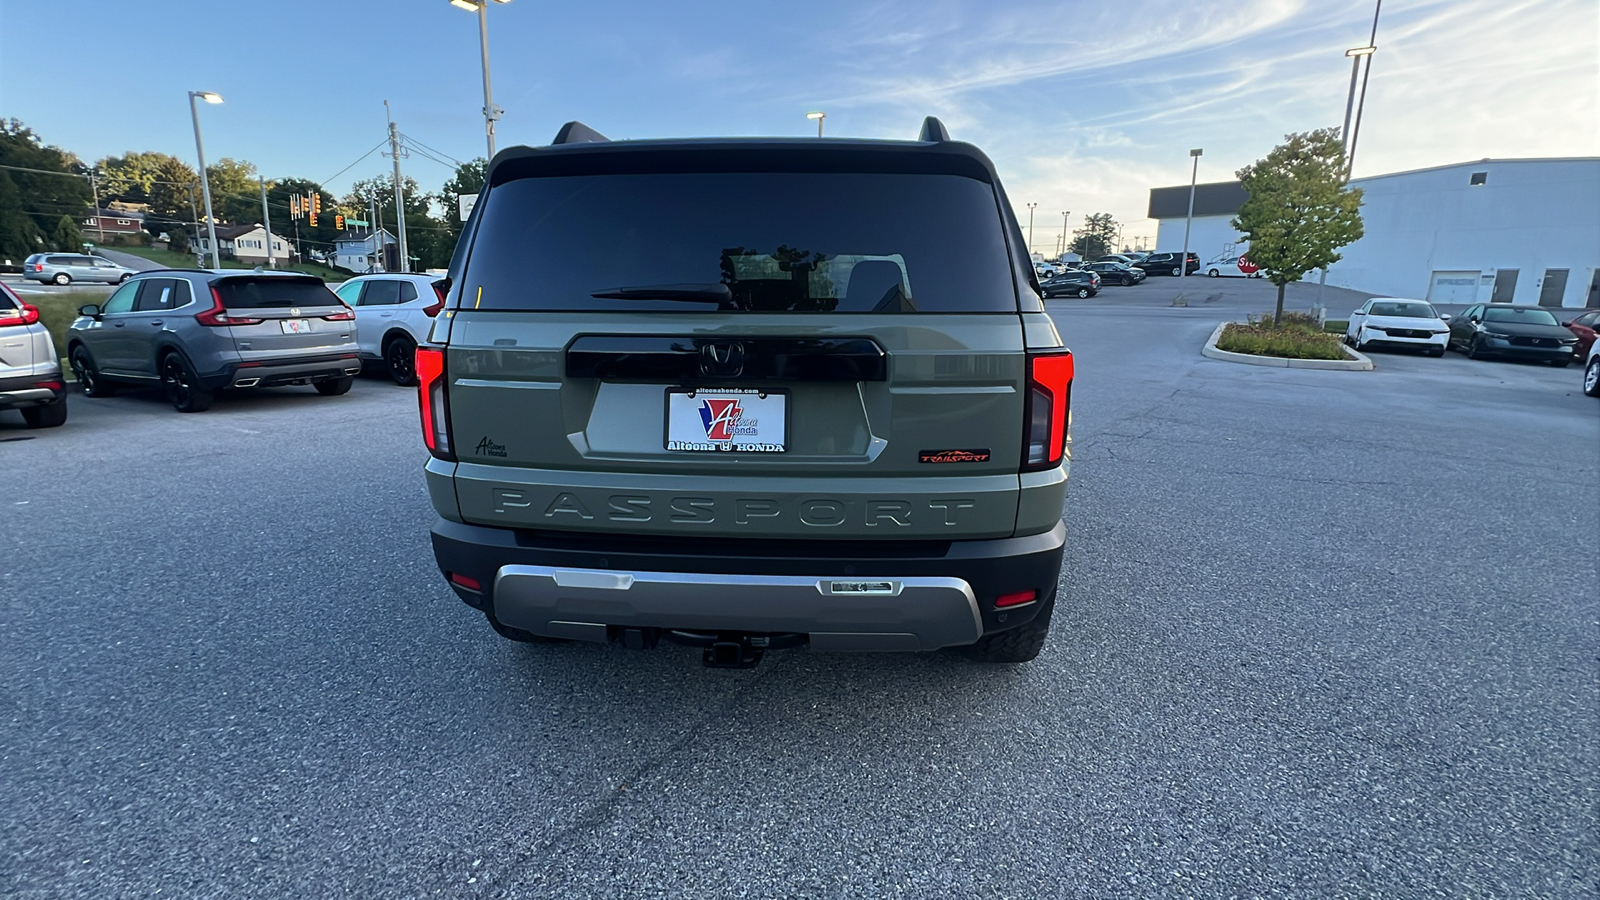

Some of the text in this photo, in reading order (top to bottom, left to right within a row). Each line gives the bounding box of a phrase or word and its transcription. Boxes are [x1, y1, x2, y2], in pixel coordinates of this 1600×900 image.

[727, 425, 758, 435] Honda
[667, 441, 716, 451] Altoona
[736, 443, 785, 452] HONDA
[921, 454, 989, 463] TRAILSPORT
[492, 487, 976, 528] PASSPORT
